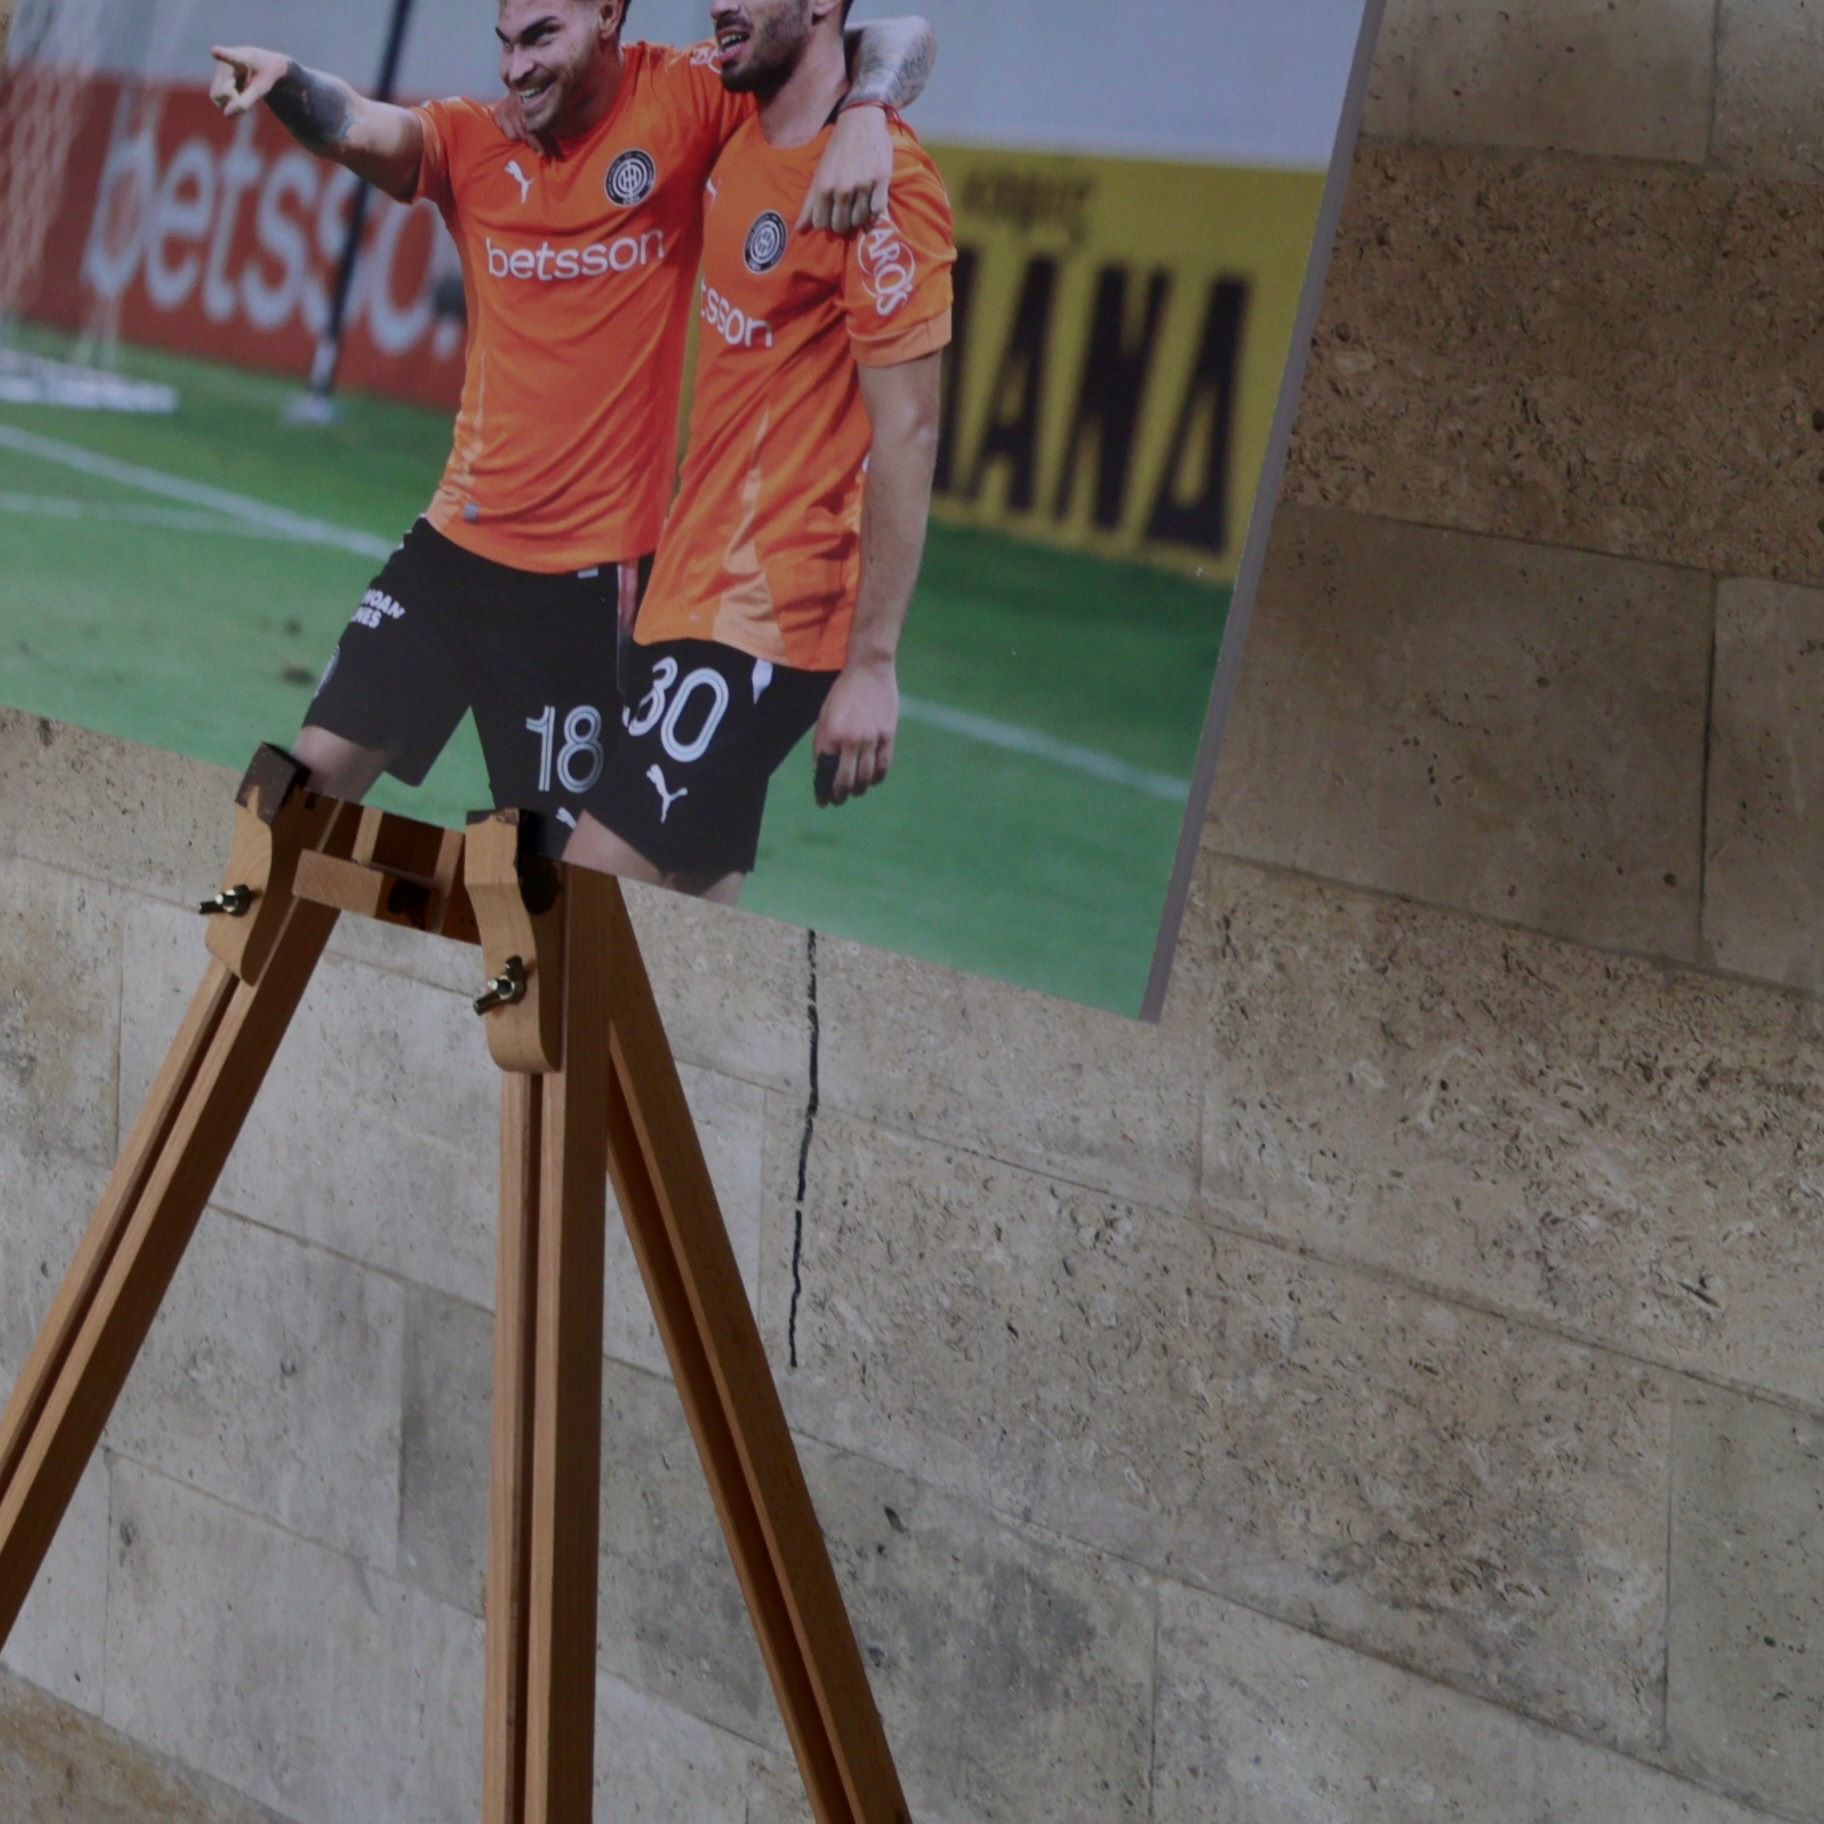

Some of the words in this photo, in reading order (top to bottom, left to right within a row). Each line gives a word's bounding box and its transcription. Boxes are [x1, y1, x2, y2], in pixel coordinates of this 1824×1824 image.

[485, 229, 665, 281] betsson
[526, 704, 604, 794] 18
[622, 655, 729, 762] 30
